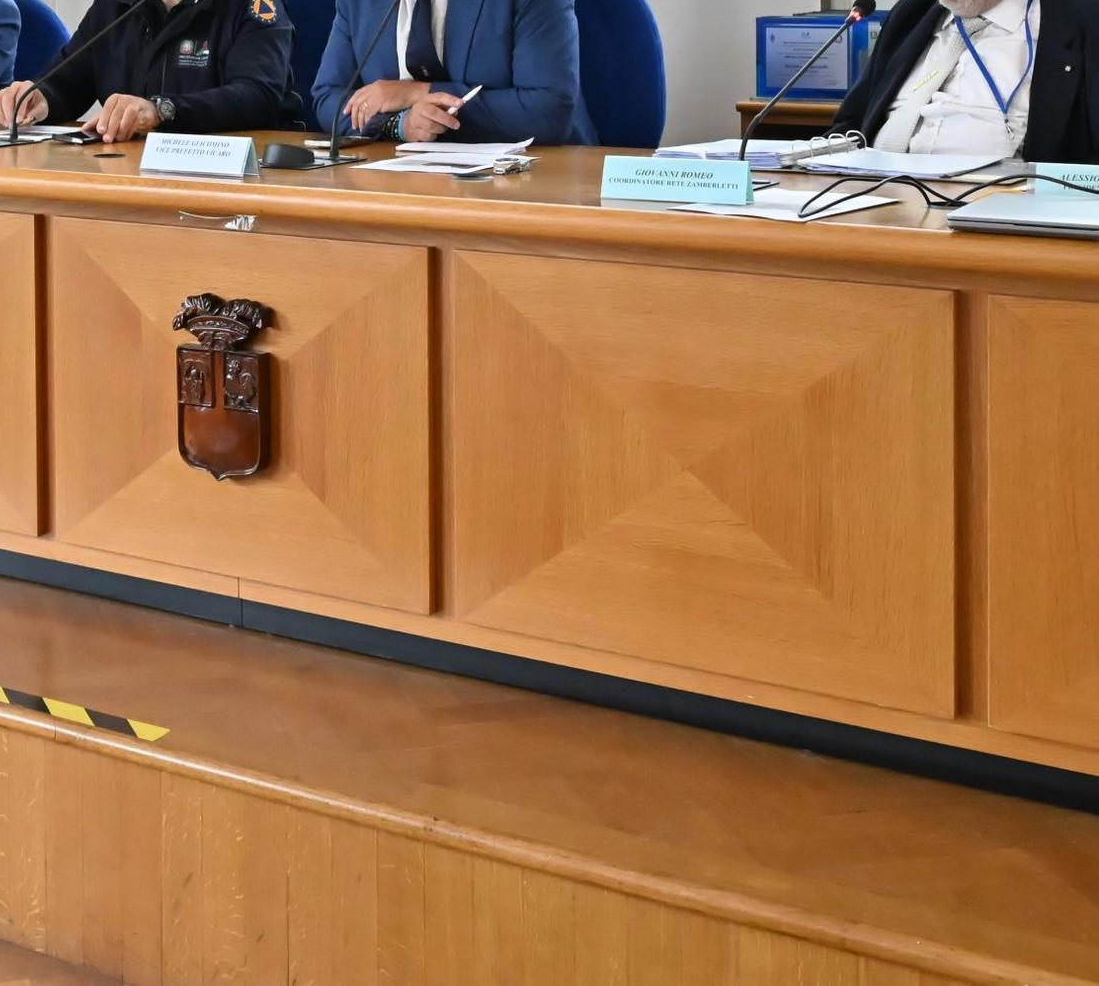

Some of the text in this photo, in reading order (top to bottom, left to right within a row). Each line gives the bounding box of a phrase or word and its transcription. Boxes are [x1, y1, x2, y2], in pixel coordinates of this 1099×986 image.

[635, 168, 714, 180] GIOVANNI ROMEO
[608, 177, 739, 190] COORDINATORE RETE ZAMBERLETTI
